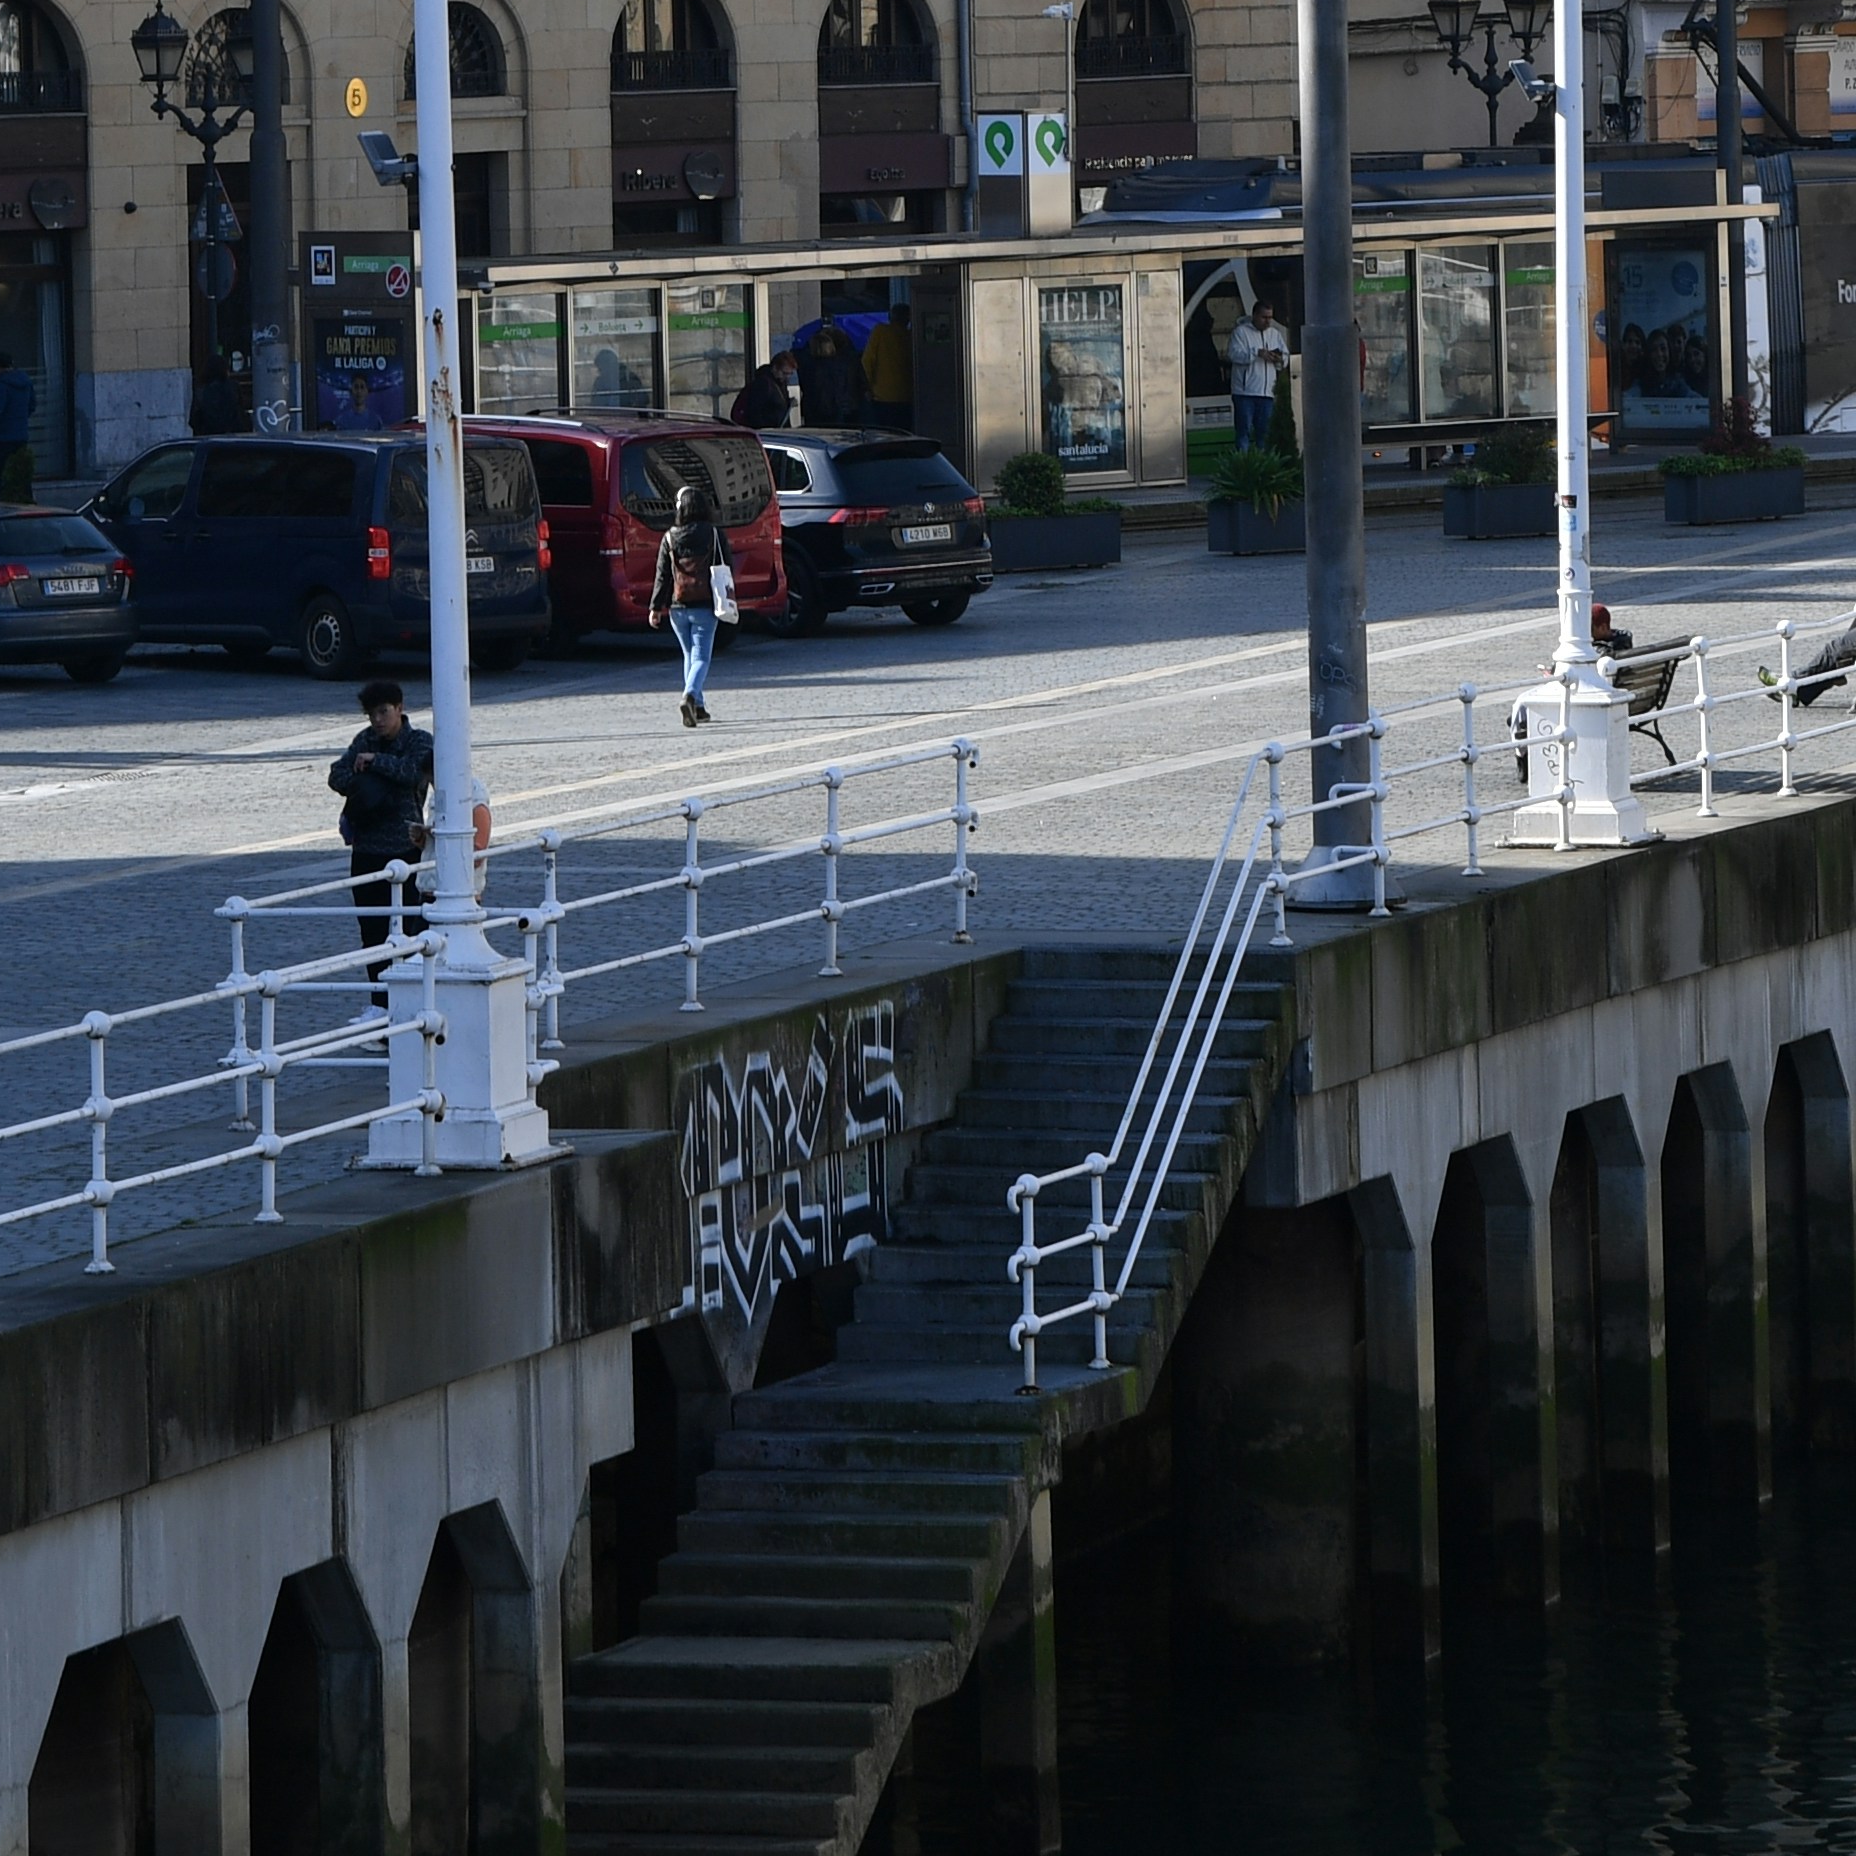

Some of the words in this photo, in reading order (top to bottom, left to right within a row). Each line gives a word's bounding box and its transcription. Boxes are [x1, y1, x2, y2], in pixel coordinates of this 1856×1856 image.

[351, 87, 362, 107] 5
[1040, 288, 1121, 324] HELP!
[691, 315, 720, 327] Arriaga
[502, 326, 532, 338] Arriaga
[326, 337, 352, 356] GANA
[354, 337, 397, 356] PREMIOS
[343, 356, 375, 370] LALIGA
[50, 579, 75, 593] 5481
